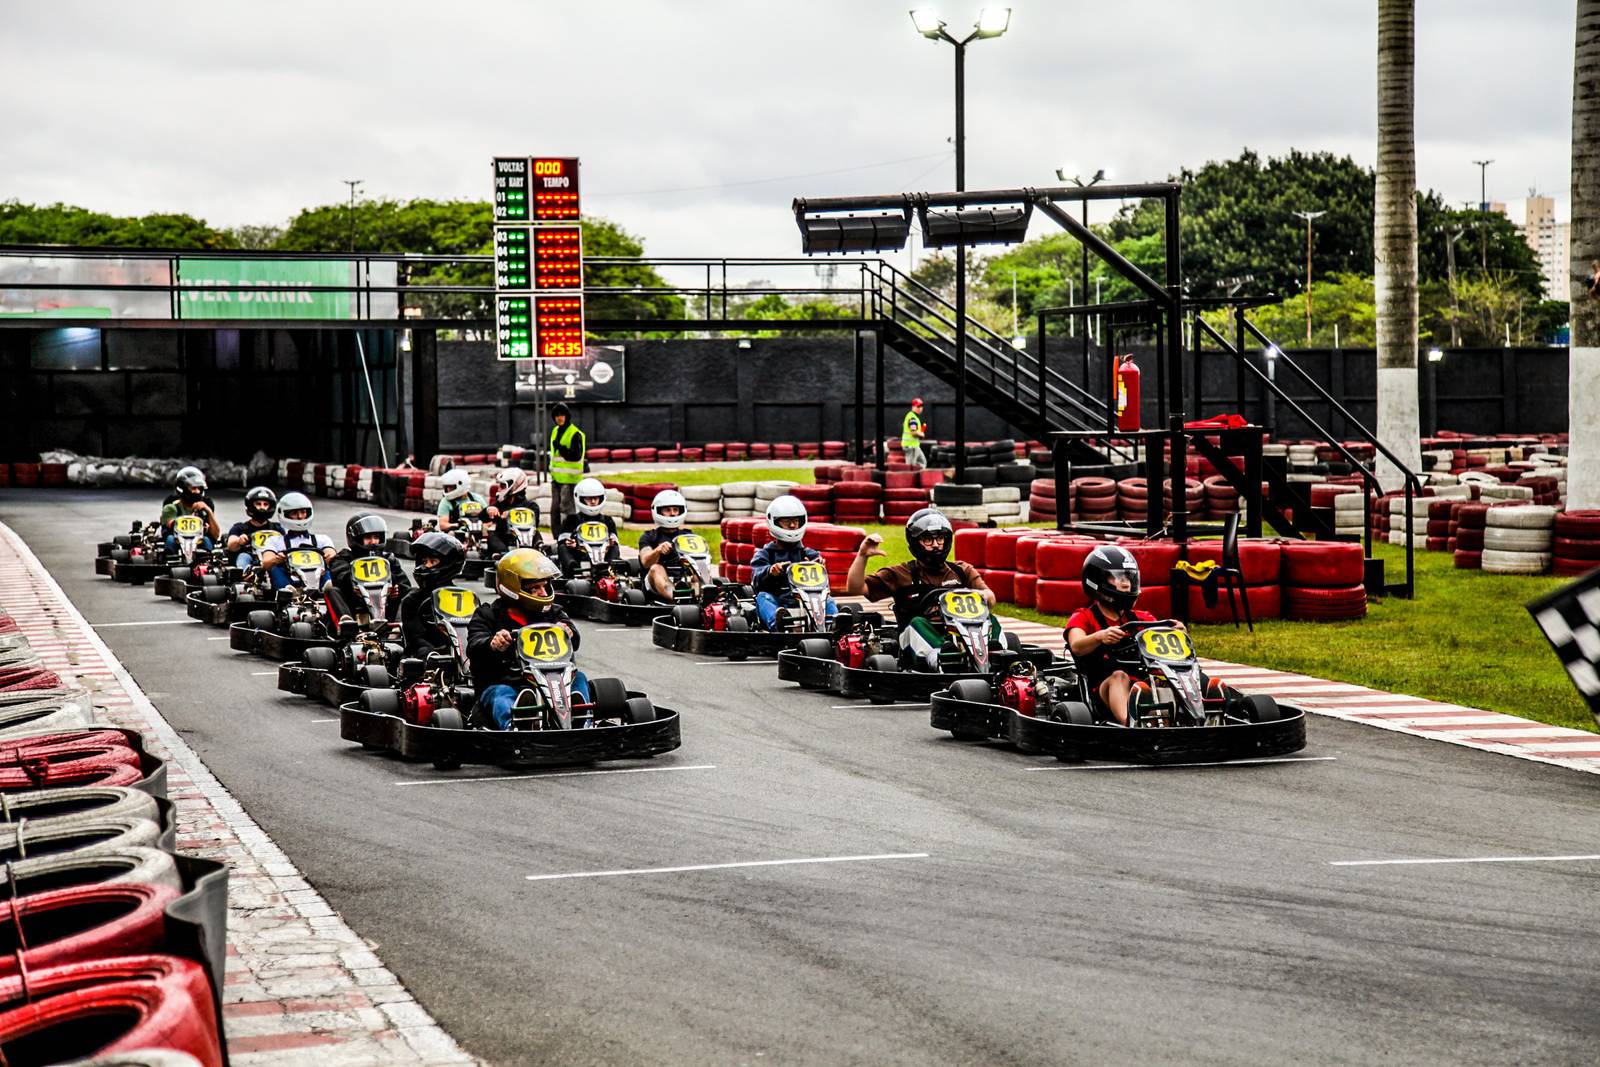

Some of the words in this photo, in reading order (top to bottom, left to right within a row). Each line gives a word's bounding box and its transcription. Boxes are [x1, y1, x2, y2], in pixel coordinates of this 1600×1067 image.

[498, 161, 525, 173] VOLTAS
[535, 161, 561, 175] 000
[496, 177, 506, 188] POS
[508, 177, 524, 188] KART
[543, 177, 570, 188] TEMPO
[496, 192, 506, 202] 01
[496, 207, 507, 217] 02
[497, 231, 508, 242] 03
[498, 246, 508, 257] 04
[497, 261, 508, 272] 05
[498, 276, 509, 286] 06
[238, 280, 313, 303] DRINK
[499, 300, 510, 311] 07
[499, 315, 510, 325] 08
[500, 329, 510, 340] 09
[501, 343, 510, 354] 10
[515, 511, 528, 523] 37
[181, 519, 196, 531] 36
[587, 526, 601, 538] 41
[687, 538, 698, 549] 5
[301, 553, 311, 564] 3
[360, 562, 381, 578] 14
[798, 567, 819, 582] 34
[451, 593, 463, 612] 7
[952, 595, 979, 614] 38
[530, 630, 561, 656] 29
[1151, 633, 1183, 655] 39
